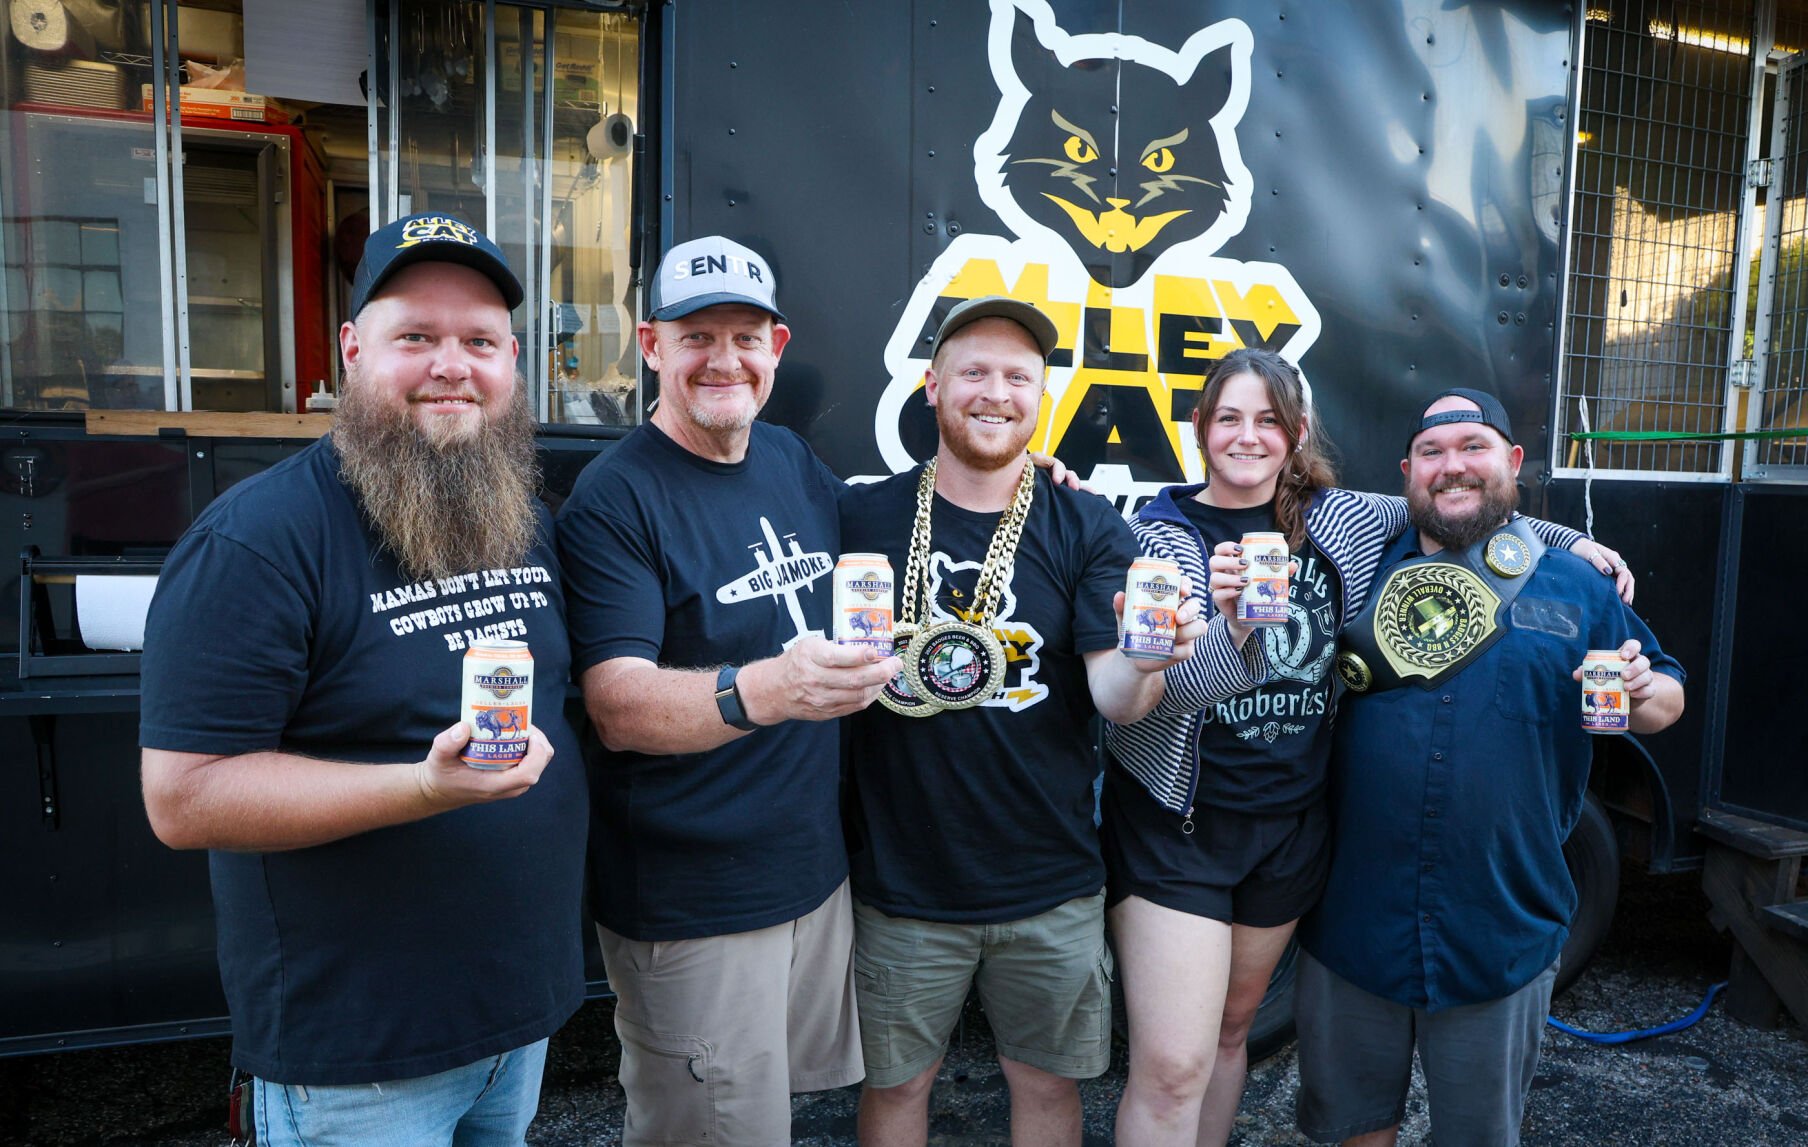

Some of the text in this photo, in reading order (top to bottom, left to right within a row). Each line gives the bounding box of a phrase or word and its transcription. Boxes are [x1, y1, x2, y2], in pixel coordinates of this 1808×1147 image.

[404, 225, 477, 244] CAT
[406, 217, 476, 233] ALLEY
[748, 556, 826, 593] BIG JAMOKE
[370, 566, 552, 613] MAMAS DON'T LET YOUR
[1399, 585, 1444, 622] OVERALL WINNER
[389, 591, 548, 636] COWBOYS GROW UP TO
[444, 618, 528, 652] BE RACISTS
[1450, 618, 1468, 644] BADGES
[1130, 636, 1173, 647] THIS LAND
[1427, 643, 1442, 651] BBQ
[475, 676, 528, 685] MARSHALL
[957, 687, 982, 700] CHAMPION
[470, 742, 527, 753] THIS LAND
